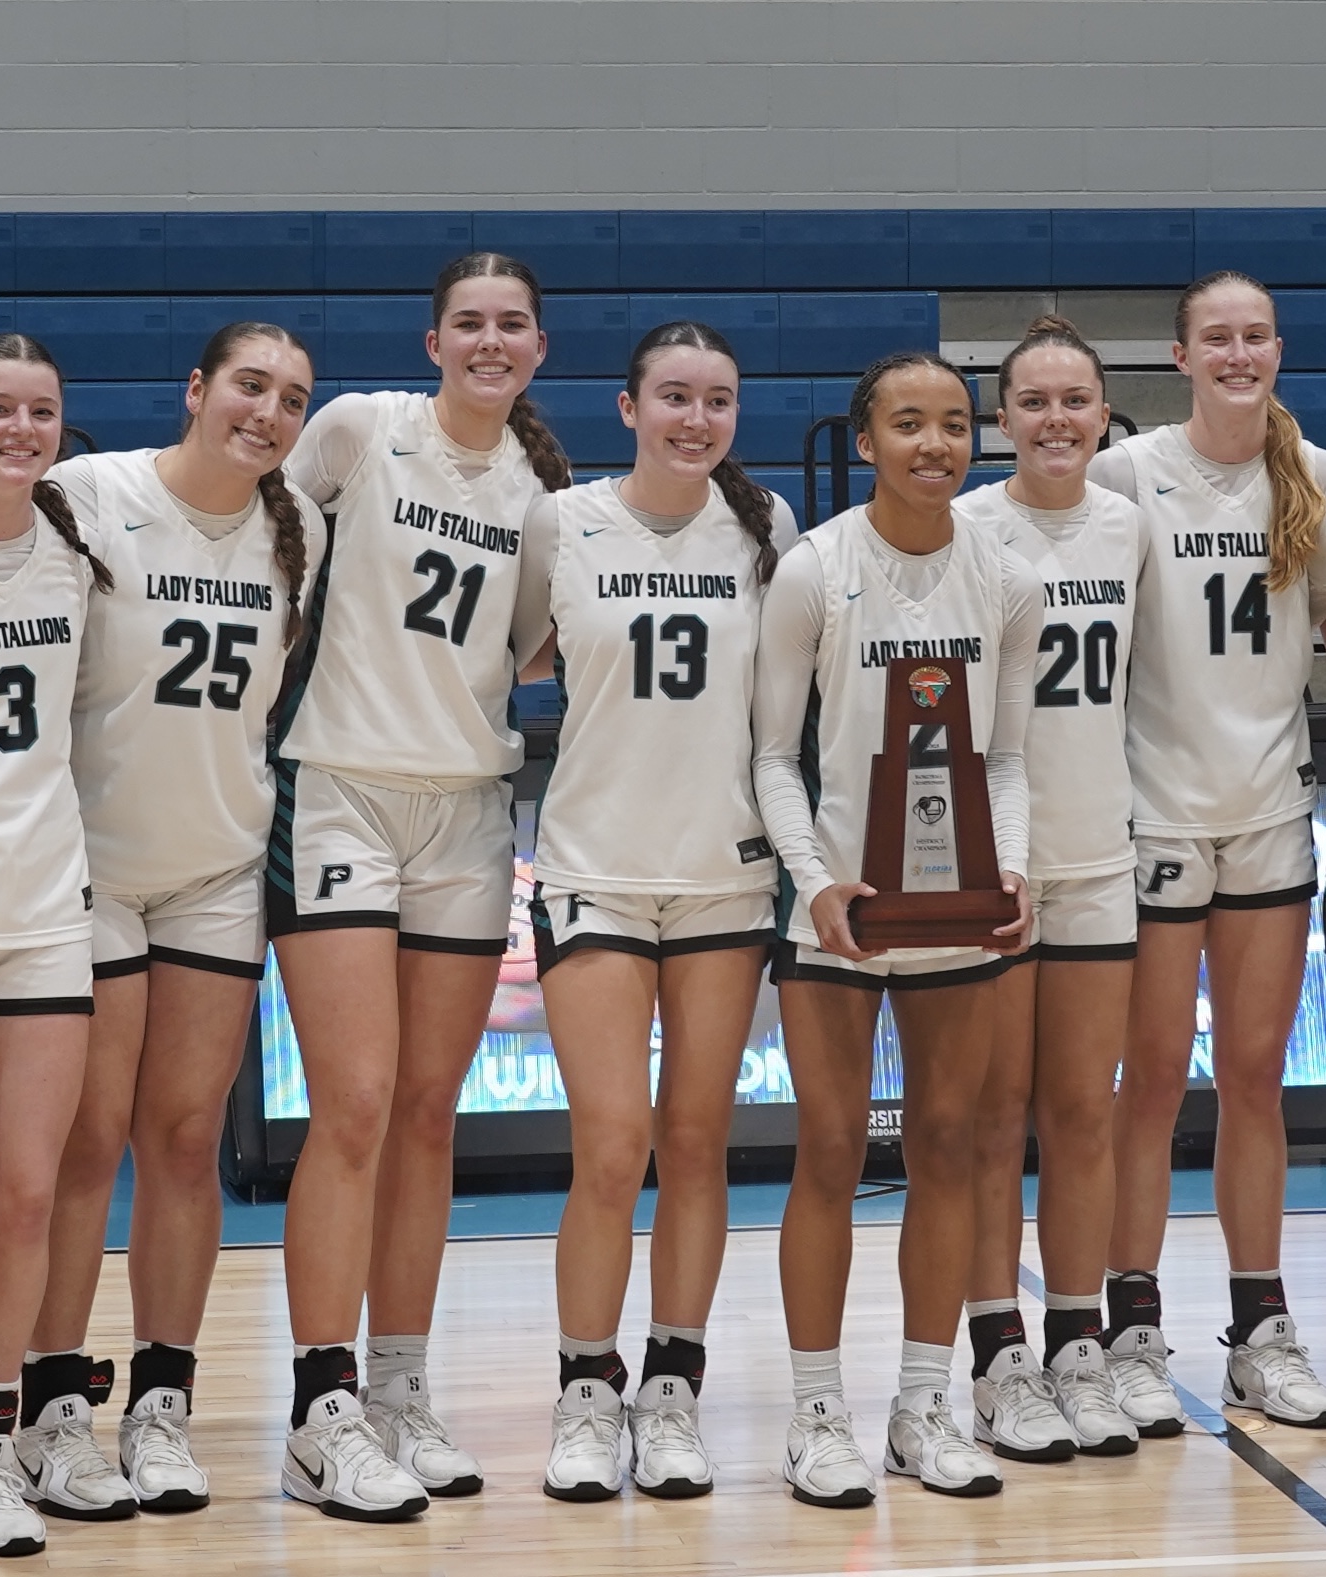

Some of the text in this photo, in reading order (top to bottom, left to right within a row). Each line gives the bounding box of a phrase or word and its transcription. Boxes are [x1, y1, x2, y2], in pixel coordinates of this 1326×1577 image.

[393, 497, 520, 556] LADY STALLIONS
[1174, 533, 1271, 558] LADY STALLI
[146, 574, 272, 611] LADY STALLIONS
[403, 548, 486, 647] 21
[598, 573, 736, 599] LADY STALLIONS
[1058, 580, 1125, 606] STALLIONS
[1204, 573, 1271, 655] 14
[154, 618, 258, 711] 25
[629, 613, 708, 700] 13
[861, 637, 981, 668] LADY STALLIONS
[1034, 620, 1118, 708] 20
